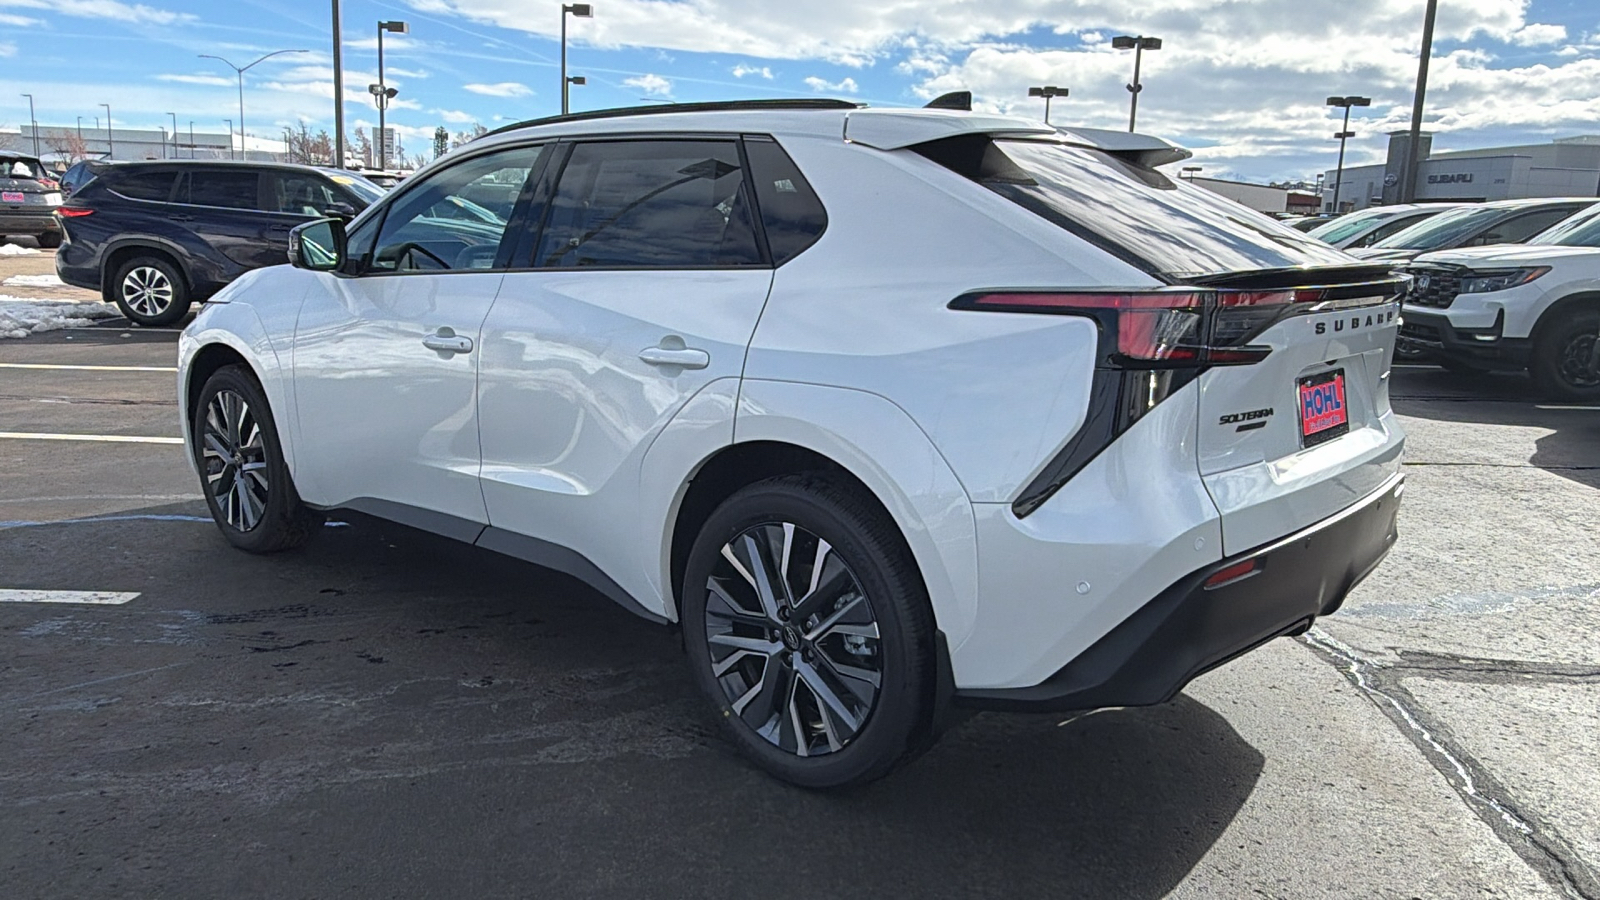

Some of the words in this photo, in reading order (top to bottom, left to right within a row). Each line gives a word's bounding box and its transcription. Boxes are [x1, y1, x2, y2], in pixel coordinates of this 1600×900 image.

[1427, 173, 1473, 184] SUBARU
[1303, 384, 1341, 419] HOHL
[1218, 407, 1274, 425] SOLTERRA
